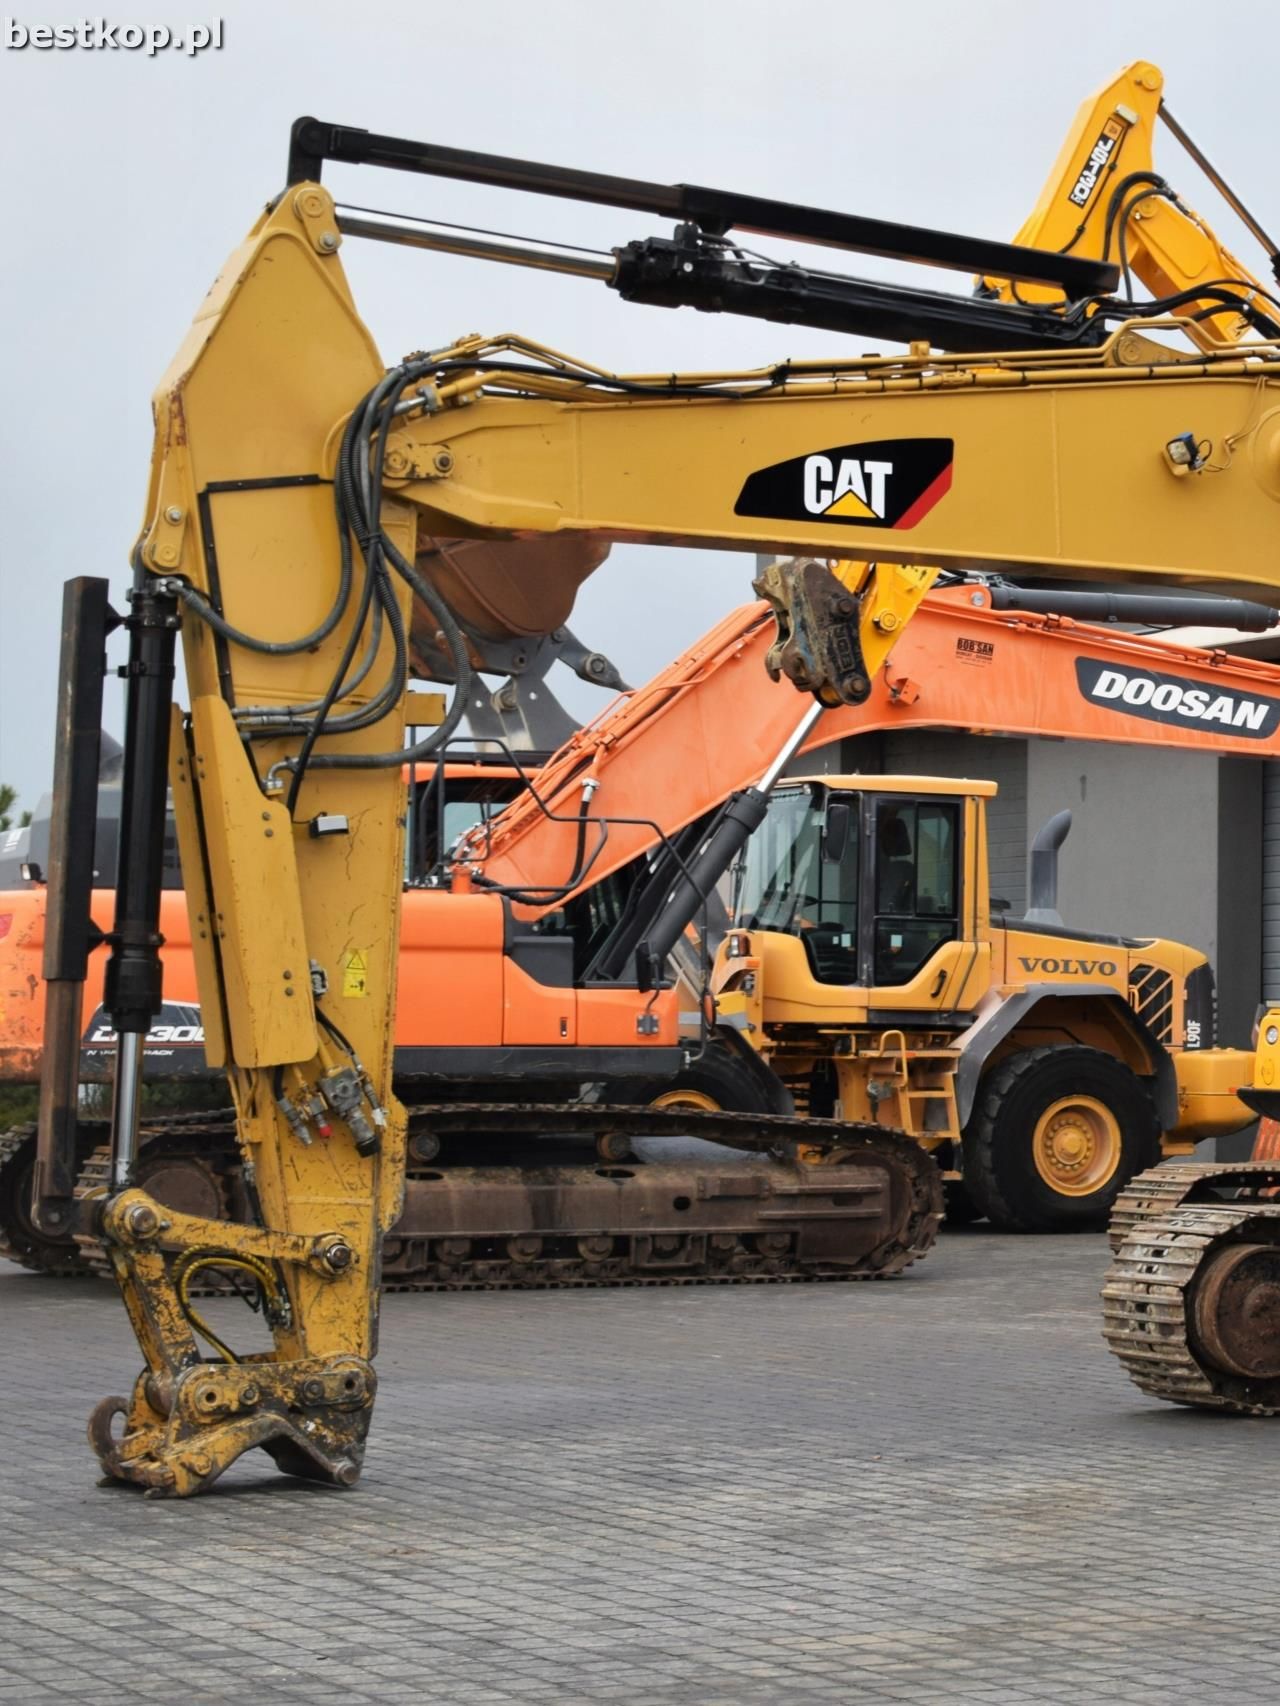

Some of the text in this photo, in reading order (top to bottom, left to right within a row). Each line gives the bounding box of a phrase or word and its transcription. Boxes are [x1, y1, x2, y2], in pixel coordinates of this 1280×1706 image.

[803, 454, 894, 519] CAT
[1091, 669, 1270, 730] DOOSAN
[1017, 956, 1118, 976] VOLVO
[1187, 1019, 1201, 1048] L90F
